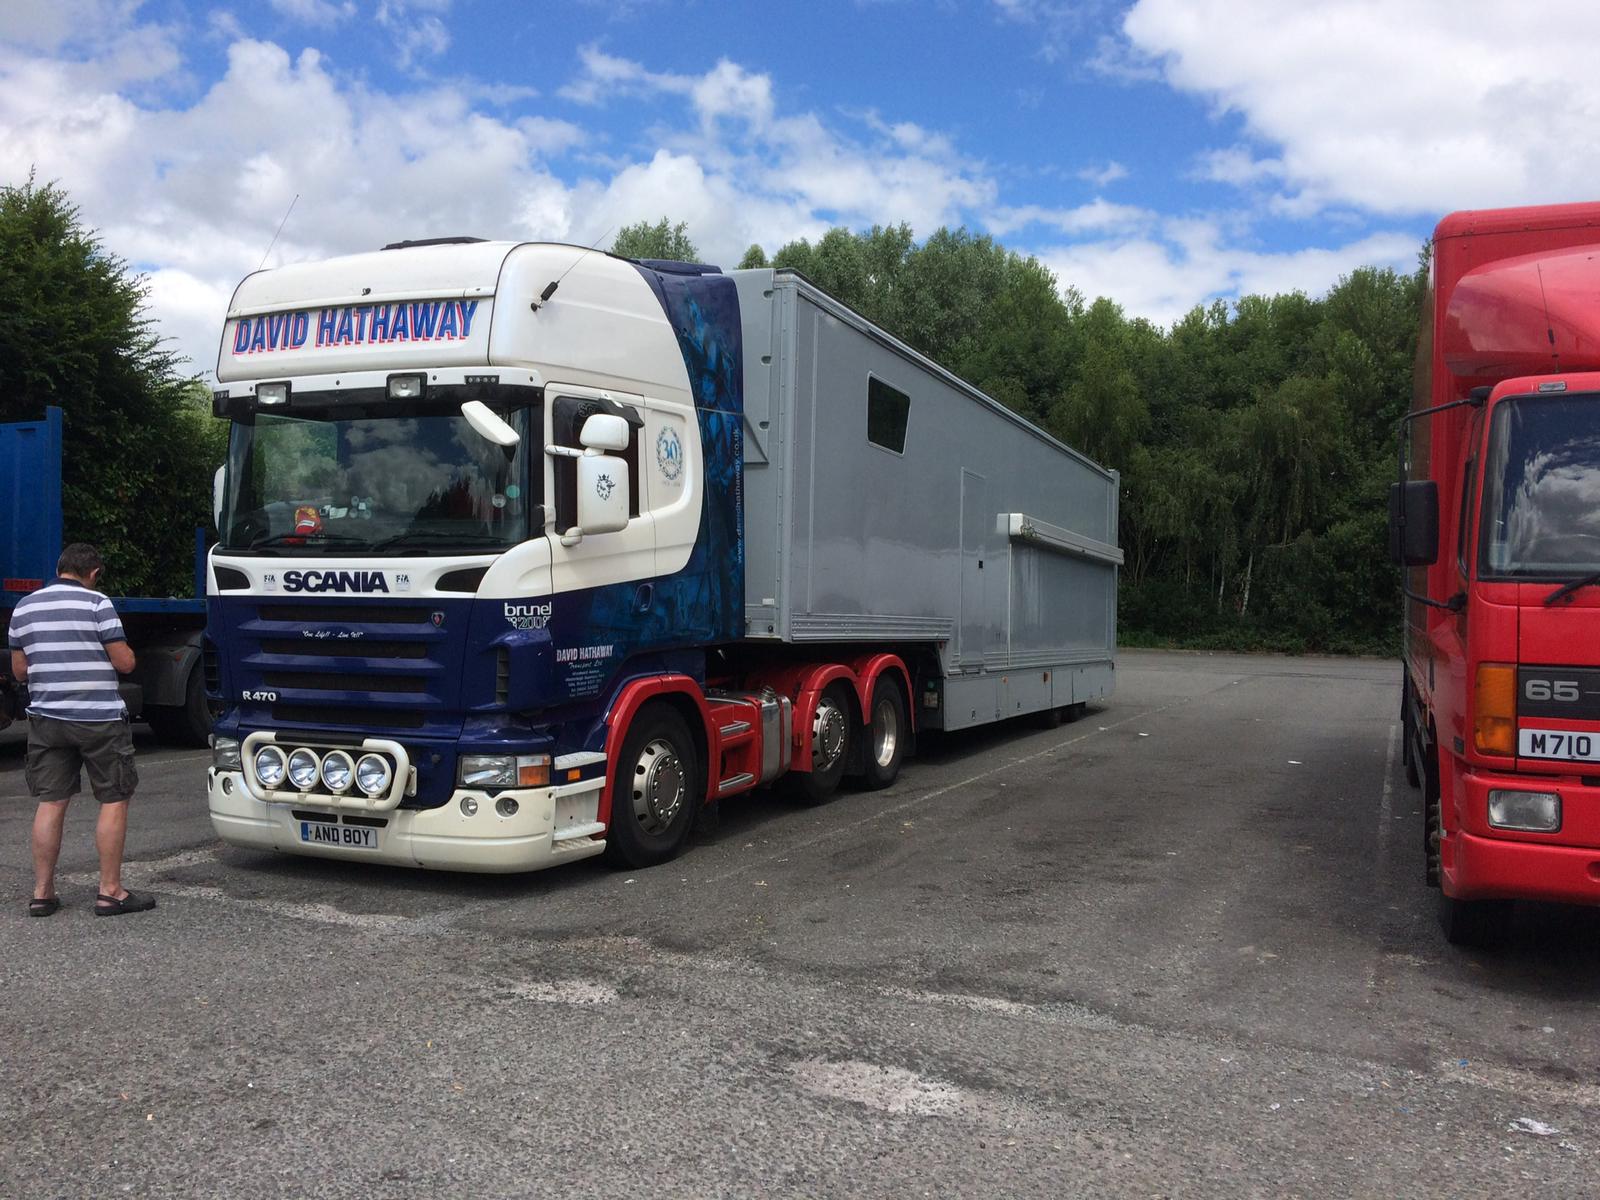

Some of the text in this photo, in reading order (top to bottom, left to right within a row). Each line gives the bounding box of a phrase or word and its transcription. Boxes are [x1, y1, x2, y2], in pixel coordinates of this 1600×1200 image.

[232, 300, 479, 355] DAVID HATHAWAY
[662, 439, 678, 459] 30
[283, 570, 390, 593] SCANIA
[504, 601, 552, 616] brunel
[517, 616, 543, 630] 200
[556, 644, 614, 662] DAVID HATHAWAY
[1525, 679, 1580, 702] 65
[1531, 733, 1592, 757] M710
[314, 825, 340, 842] AND
